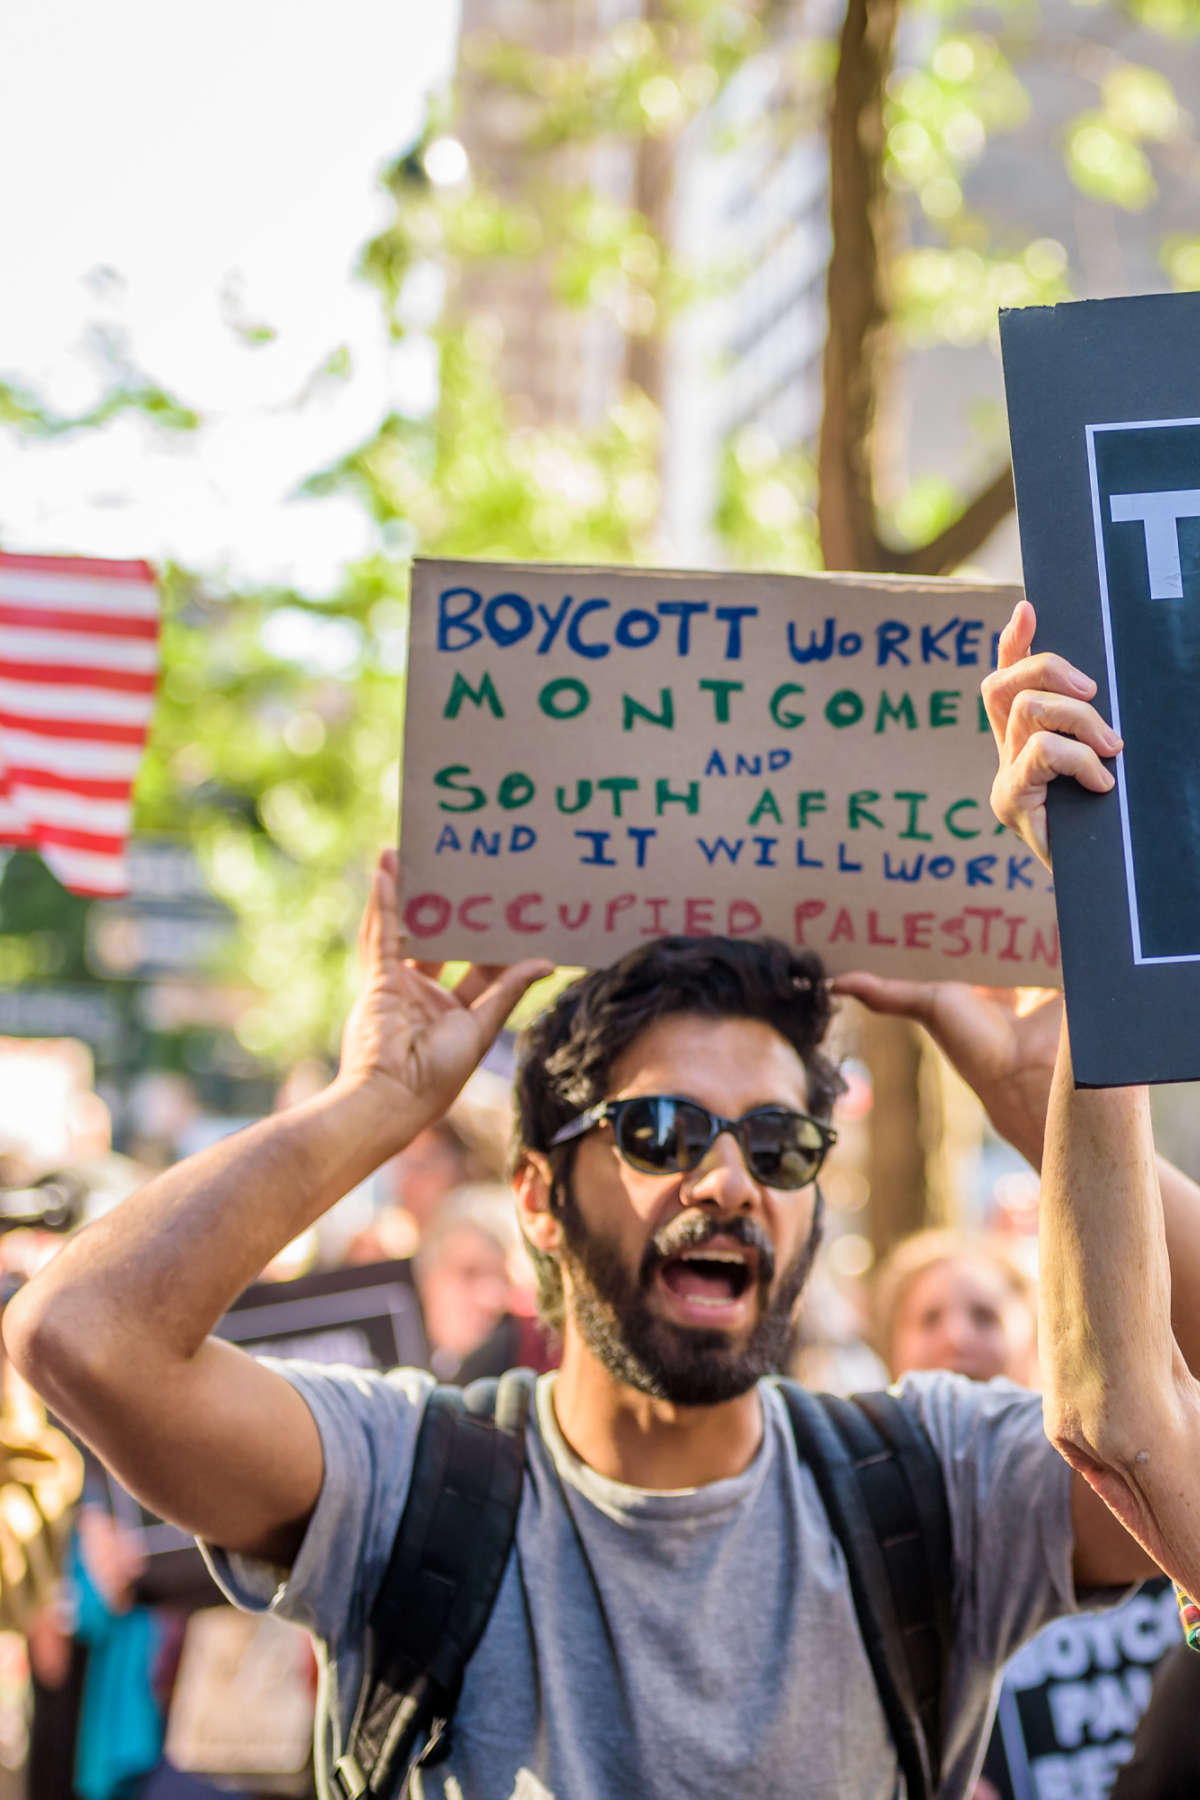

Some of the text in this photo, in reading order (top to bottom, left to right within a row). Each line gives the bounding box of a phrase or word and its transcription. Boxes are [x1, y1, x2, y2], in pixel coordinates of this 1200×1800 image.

[437, 586, 758, 660] BOYCOTT
[704, 749, 793, 776] AND
[433, 765, 700, 817] SOUTH
[435, 824, 537, 856] AND
[574, 828, 656, 868] IT
[697, 836, 862, 872] WILL
[403, 893, 1060, 968] OCCUPIED PALESTIN
